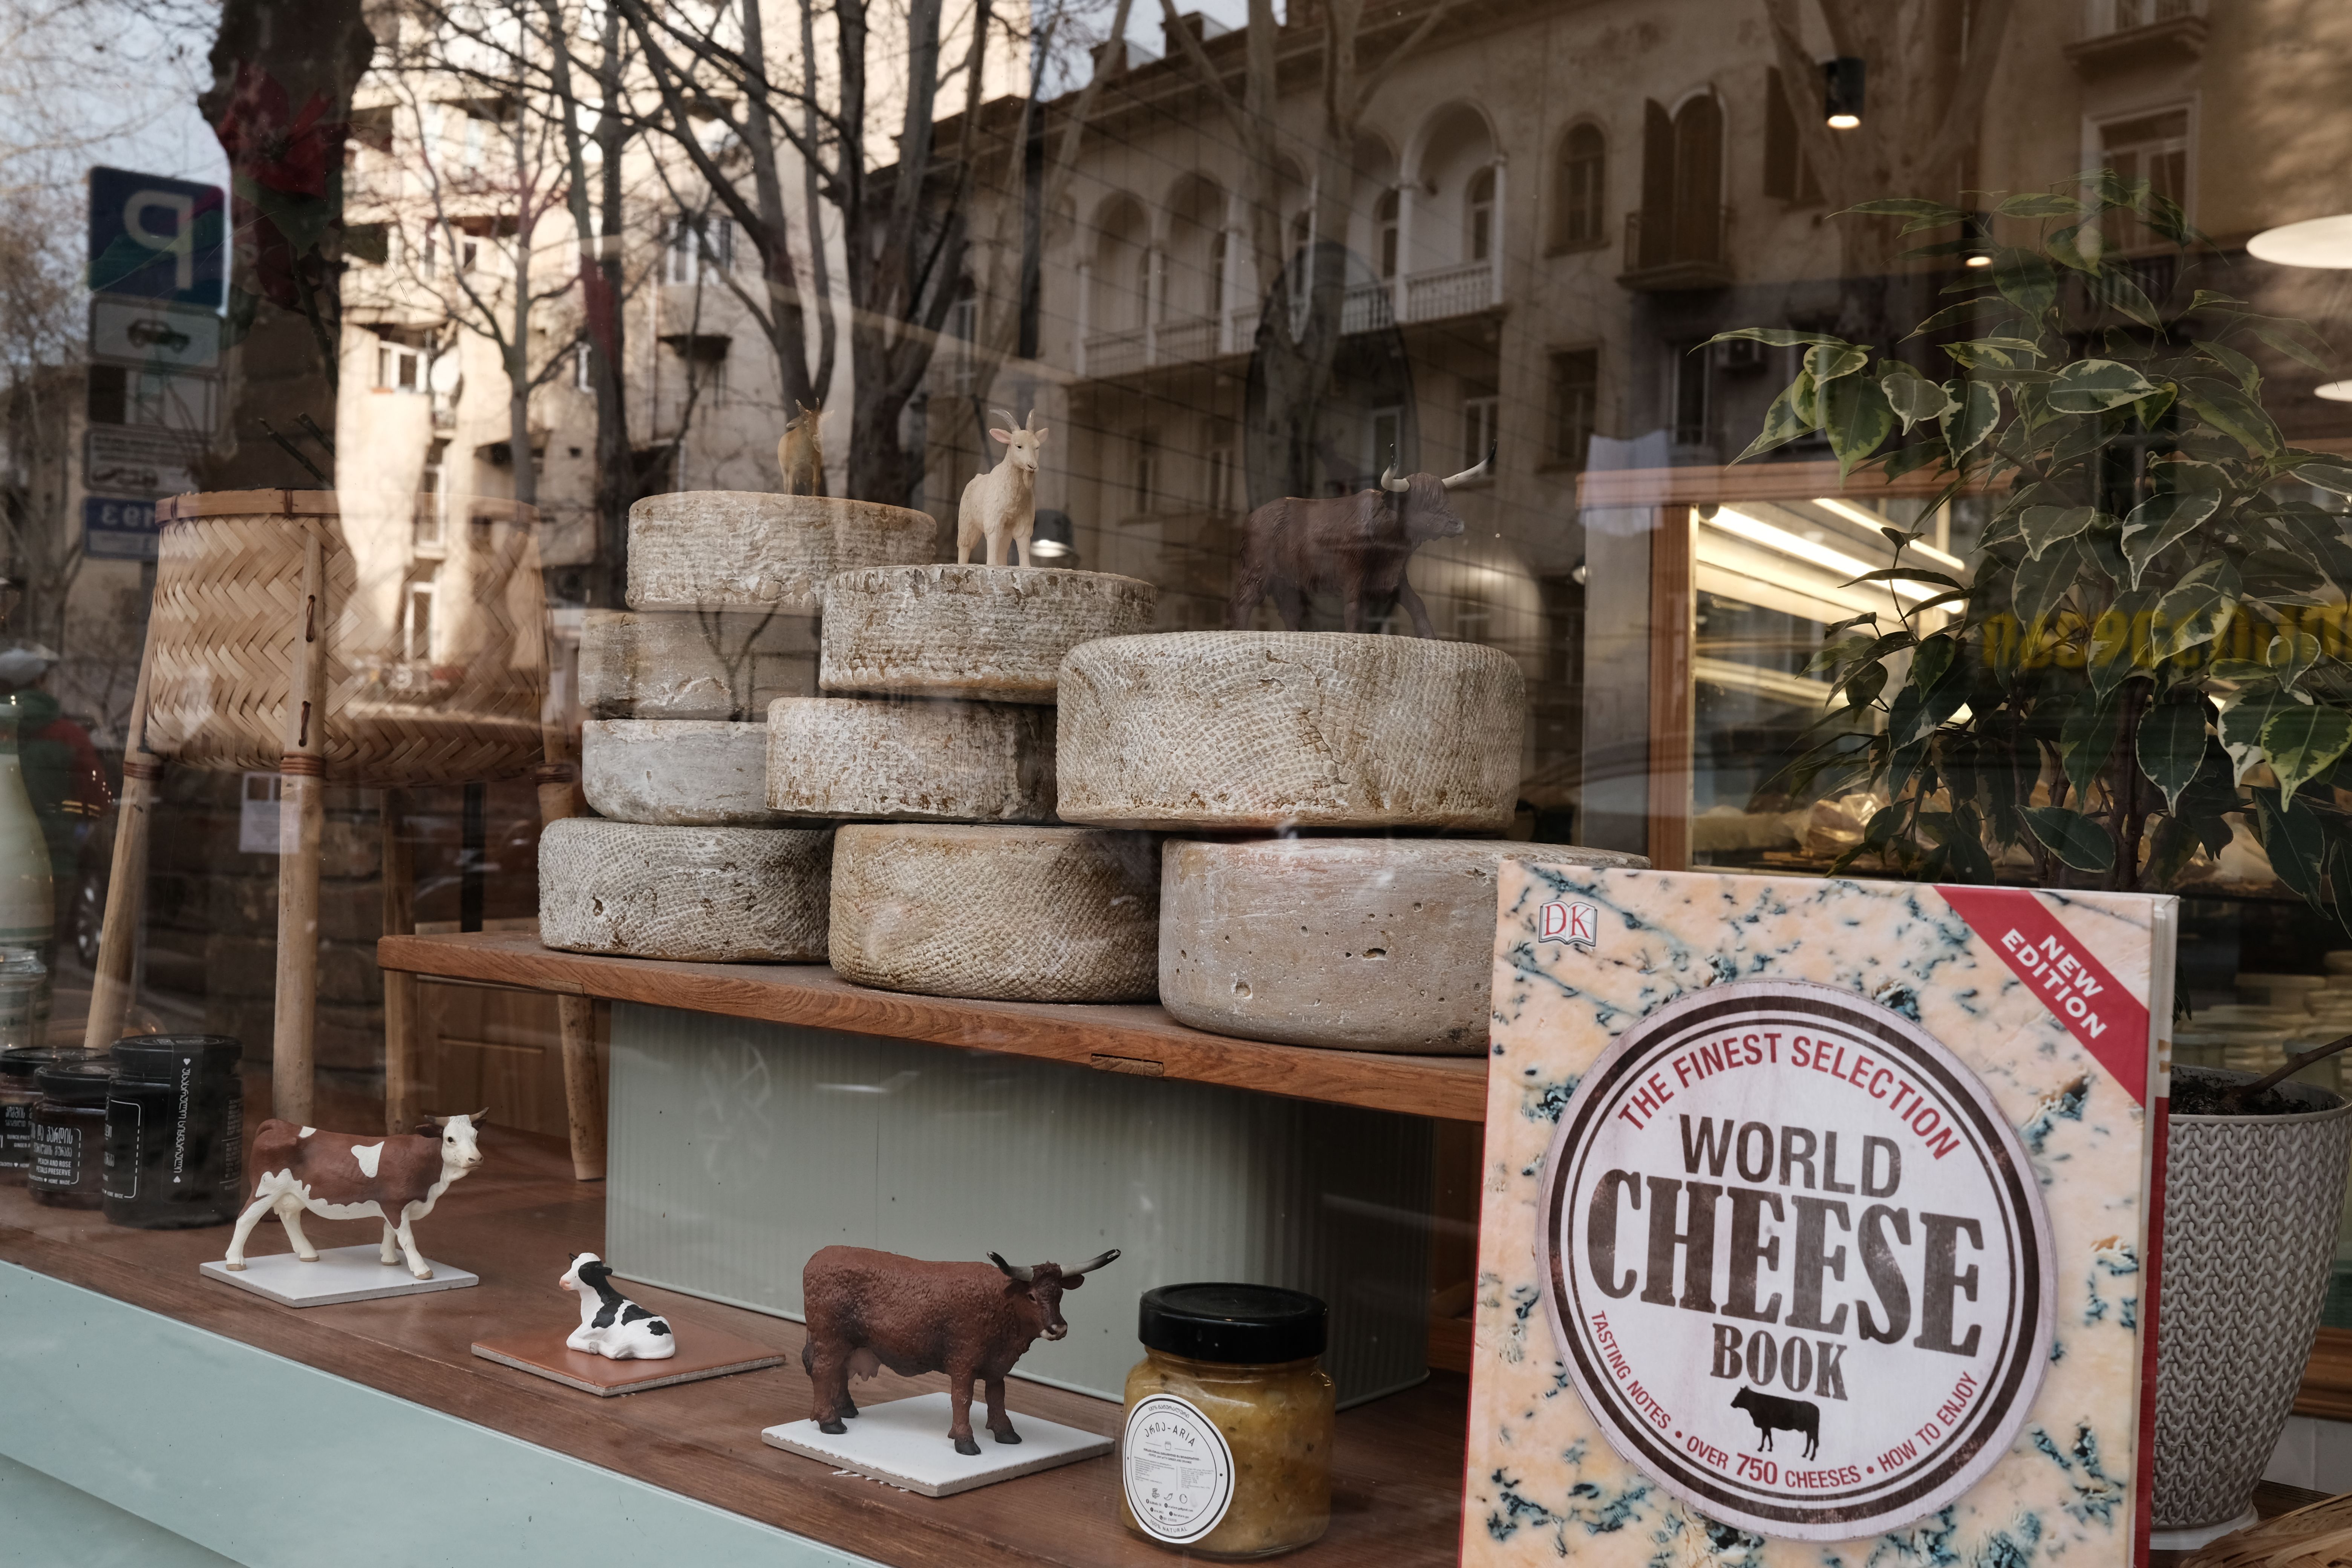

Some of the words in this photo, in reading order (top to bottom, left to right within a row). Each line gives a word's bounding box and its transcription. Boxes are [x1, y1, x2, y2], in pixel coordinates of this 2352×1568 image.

[1544, 904, 1591, 939] DK
[2001, 928, 2107, 1039] EDITION
[2038, 934, 2104, 997] NEW
[1618, 1073, 1674, 1130] THE
[1672, 1033, 1781, 1088] FINEST
[1791, 1036, 1960, 1160] SELECTION
[47, 1126, 73, 1144] ვარდის
[174, 1121, 186, 1173] სიყვარული
[1679, 1113, 1901, 1198] WORLD
[36, 1165, 47, 1173] PETALS
[48, 1167, 71, 1176] PRESERVE
[1587, 1168, 1984, 1357] CHEESE
[1710, 1323, 1848, 1401] BOOK
[1592, 1311, 1631, 1380] TASTING
[1627, 1380, 1671, 1429] NOTES
[1687, 1436, 1729, 1470] OVER
[1736, 1453, 1778, 1484] 750
[1785, 1465, 1861, 1489] CHEESES
[1877, 1439, 1917, 1473] HOW
[1915, 1423, 1941, 1446] TO
[1937, 1371, 1978, 1427] ENJOY
[1150, 1519, 1161, 1529] 100%
